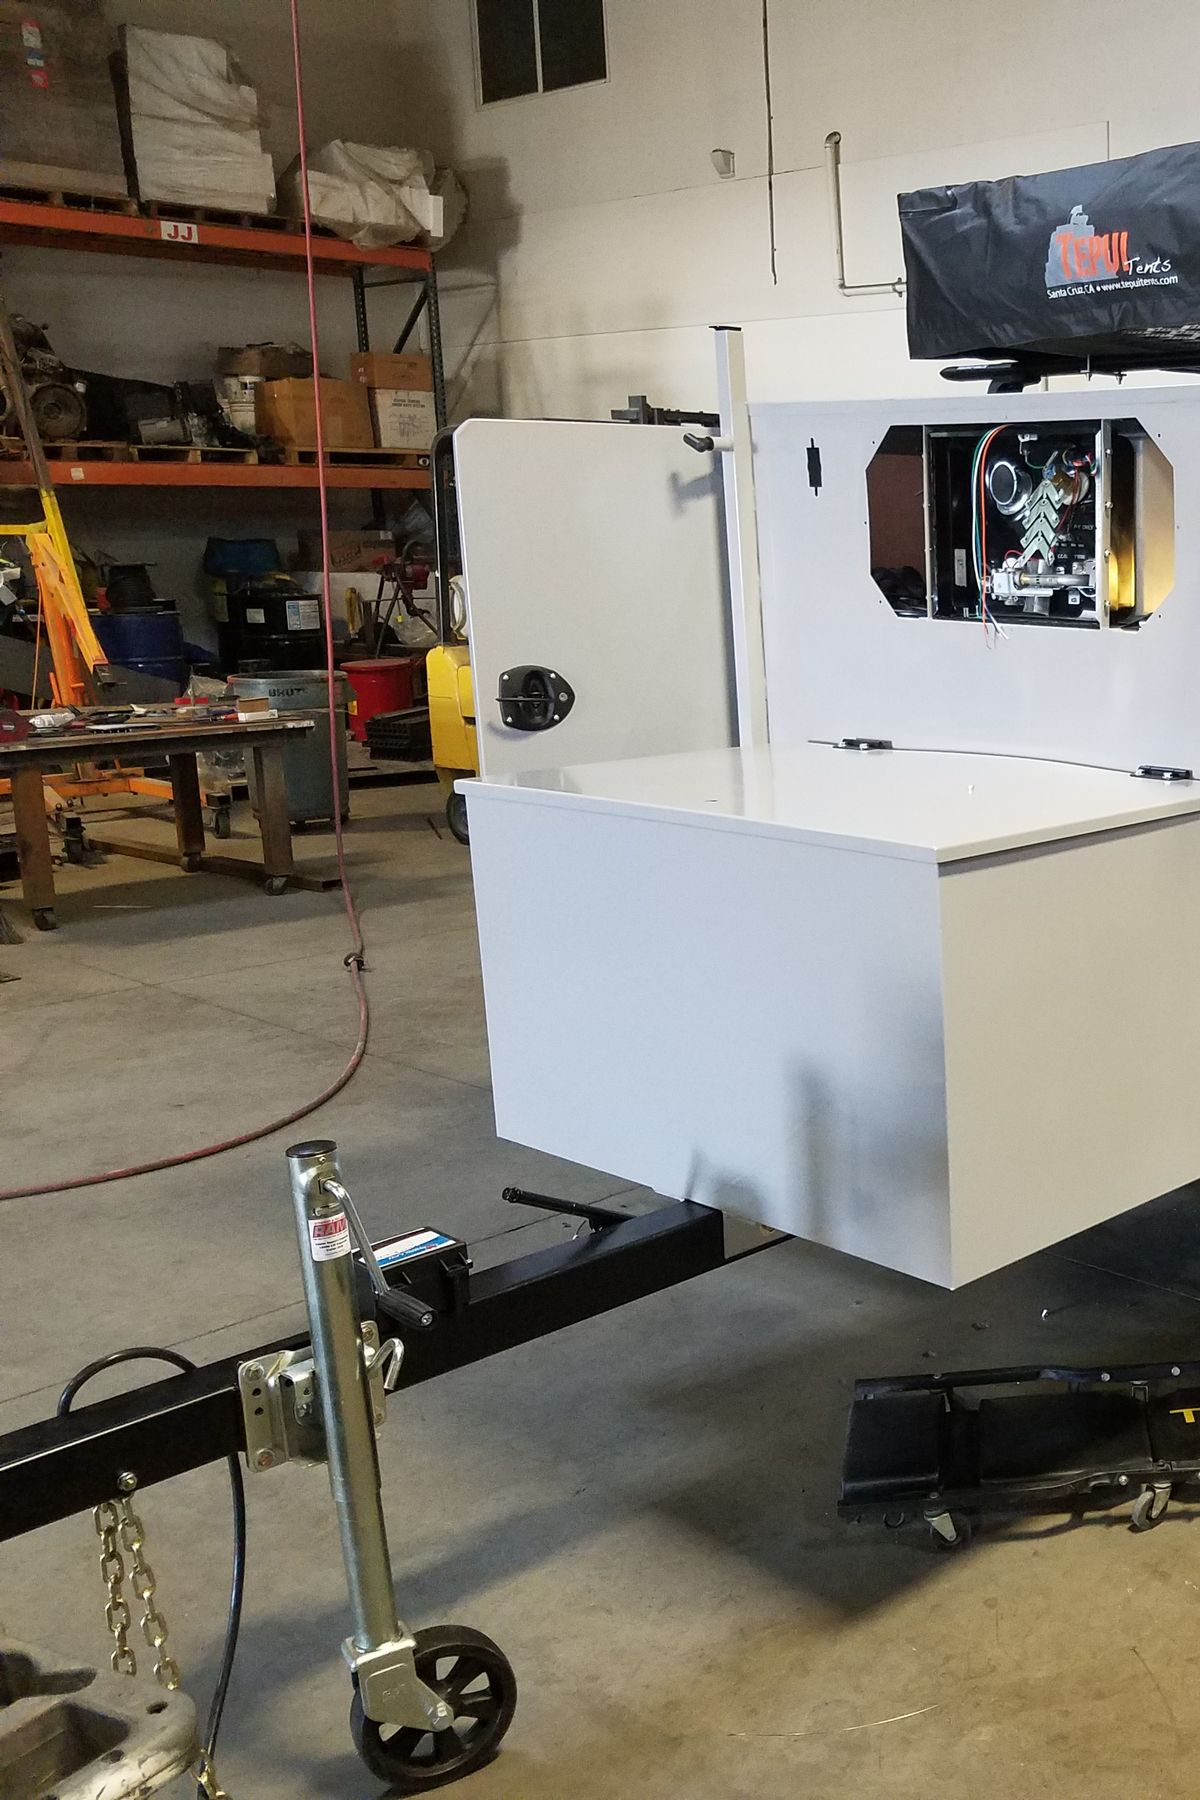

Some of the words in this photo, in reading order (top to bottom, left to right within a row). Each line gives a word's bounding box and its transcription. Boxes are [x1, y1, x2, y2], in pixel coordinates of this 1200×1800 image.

[166, 224, 193, 241] JJ
[1056, 231, 1130, 280] TEPUI
[1124, 256, 1172, 276] Tents
[1047, 288, 1068, 299] Santa
[1101, 275, 1179, 292] www.tepuitents.com
